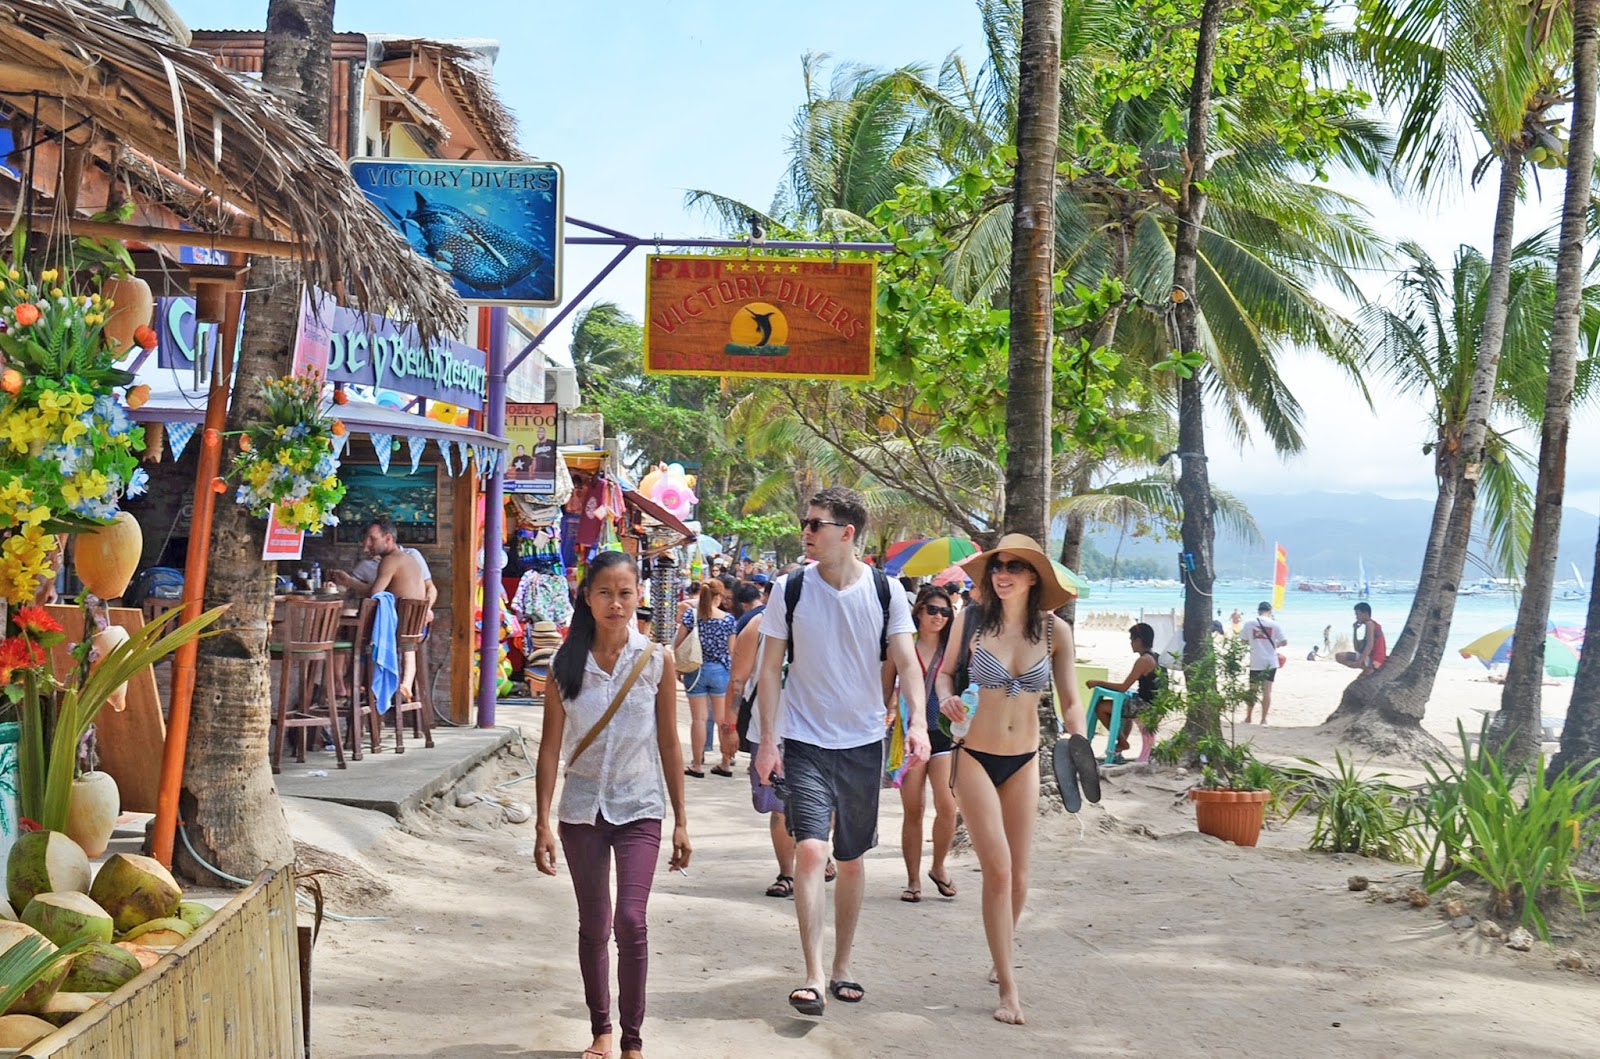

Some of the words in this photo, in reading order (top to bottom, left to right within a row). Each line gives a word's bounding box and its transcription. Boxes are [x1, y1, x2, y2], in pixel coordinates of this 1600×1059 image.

[368, 167, 466, 187] VICTORY
[471, 169, 551, 190] DIVERS
[654, 261, 721, 279] PADI
[651, 275, 770, 335] VICTORY
[776, 276, 866, 340] DIVERS
[389, 333, 441, 390] Beach
[443, 351, 488, 398] Resort
[505, 415, 556, 427] TTOO
